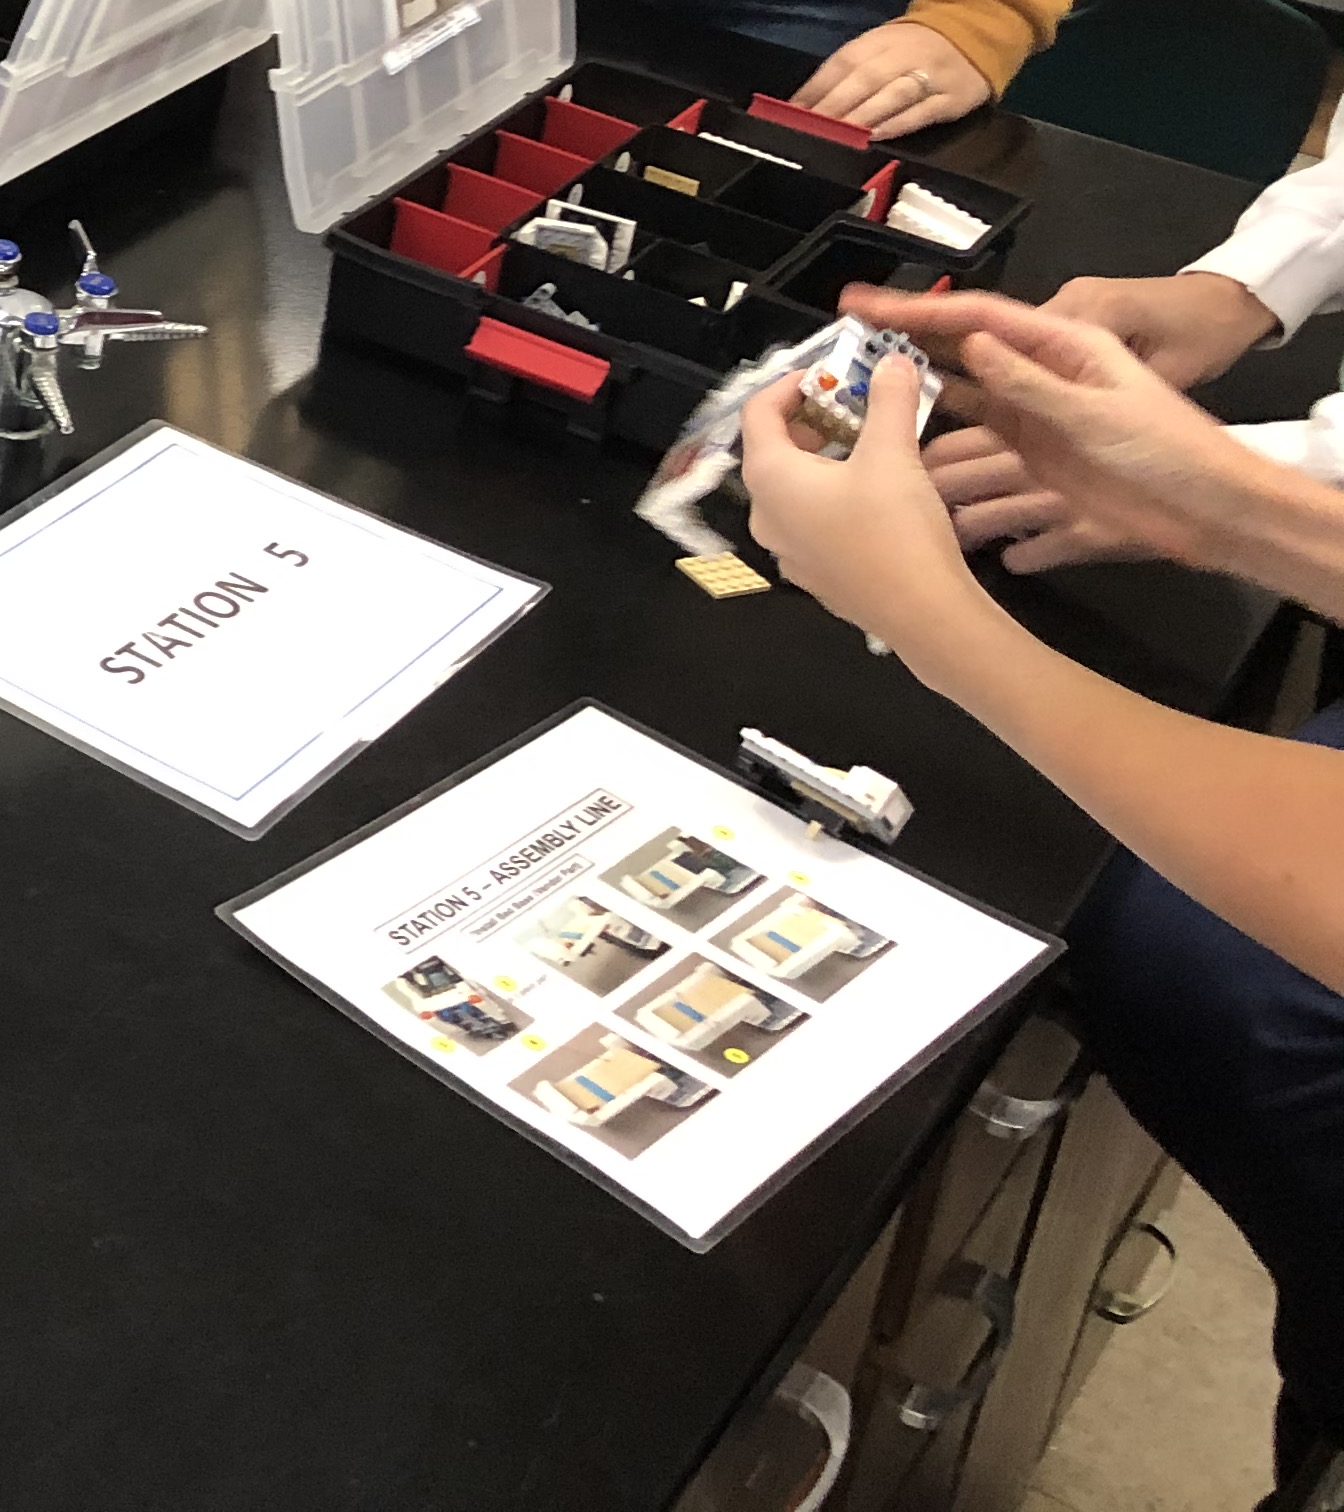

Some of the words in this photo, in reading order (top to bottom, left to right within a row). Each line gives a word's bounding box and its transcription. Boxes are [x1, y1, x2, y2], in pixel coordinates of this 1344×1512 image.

[99, 570, 270, 685] STATION
[262, 540, 311, 569] 5
[388, 894, 470, 947] STATION
[461, 885, 483, 901] 5
[489, 819, 582, 885] ASSEMBLY
[573, 794, 623, 827] LINE
